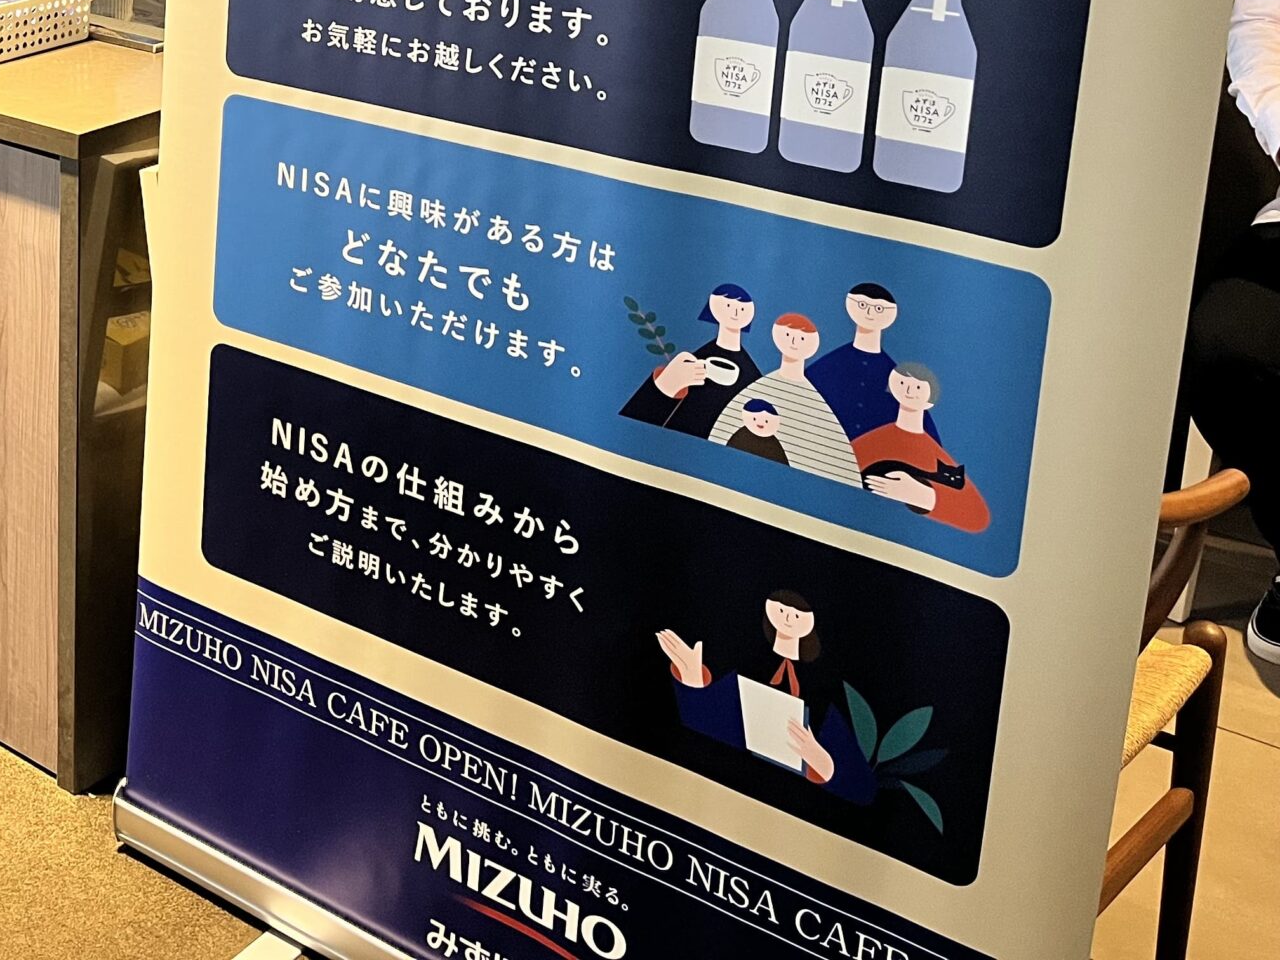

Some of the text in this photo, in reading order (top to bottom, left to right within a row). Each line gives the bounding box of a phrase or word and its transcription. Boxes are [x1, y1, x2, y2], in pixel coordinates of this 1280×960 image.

[301, 18, 608, 101] お気軽にお越しください。
[721, 71, 748, 83] NISA
[811, 87, 839, 100] NISA
[910, 104, 940, 117] NISA
[277, 161, 617, 272] NISAに興味がある方は
[341, 228, 530, 312] どなたでも
[289, 266, 582, 378] ご参加いただけます。
[260, 461, 587, 614] 始め方まで、分かりやすく
[271, 417, 580, 555] NISAの仕組みから
[308, 531, 522, 638] ご説明いたします。
[138, 602, 243, 671] MIZUHO
[250, 654, 317, 708] NISA
[327, 692, 410, 750] CAFE
[419, 734, 519, 800] OPEN!
[528, 781, 674, 872] MIZUHO
[686, 854, 780, 925] NISA
[414, 820, 628, 960] MIZUHO
[421, 794, 629, 912] ともに挑む。ともに実る。
